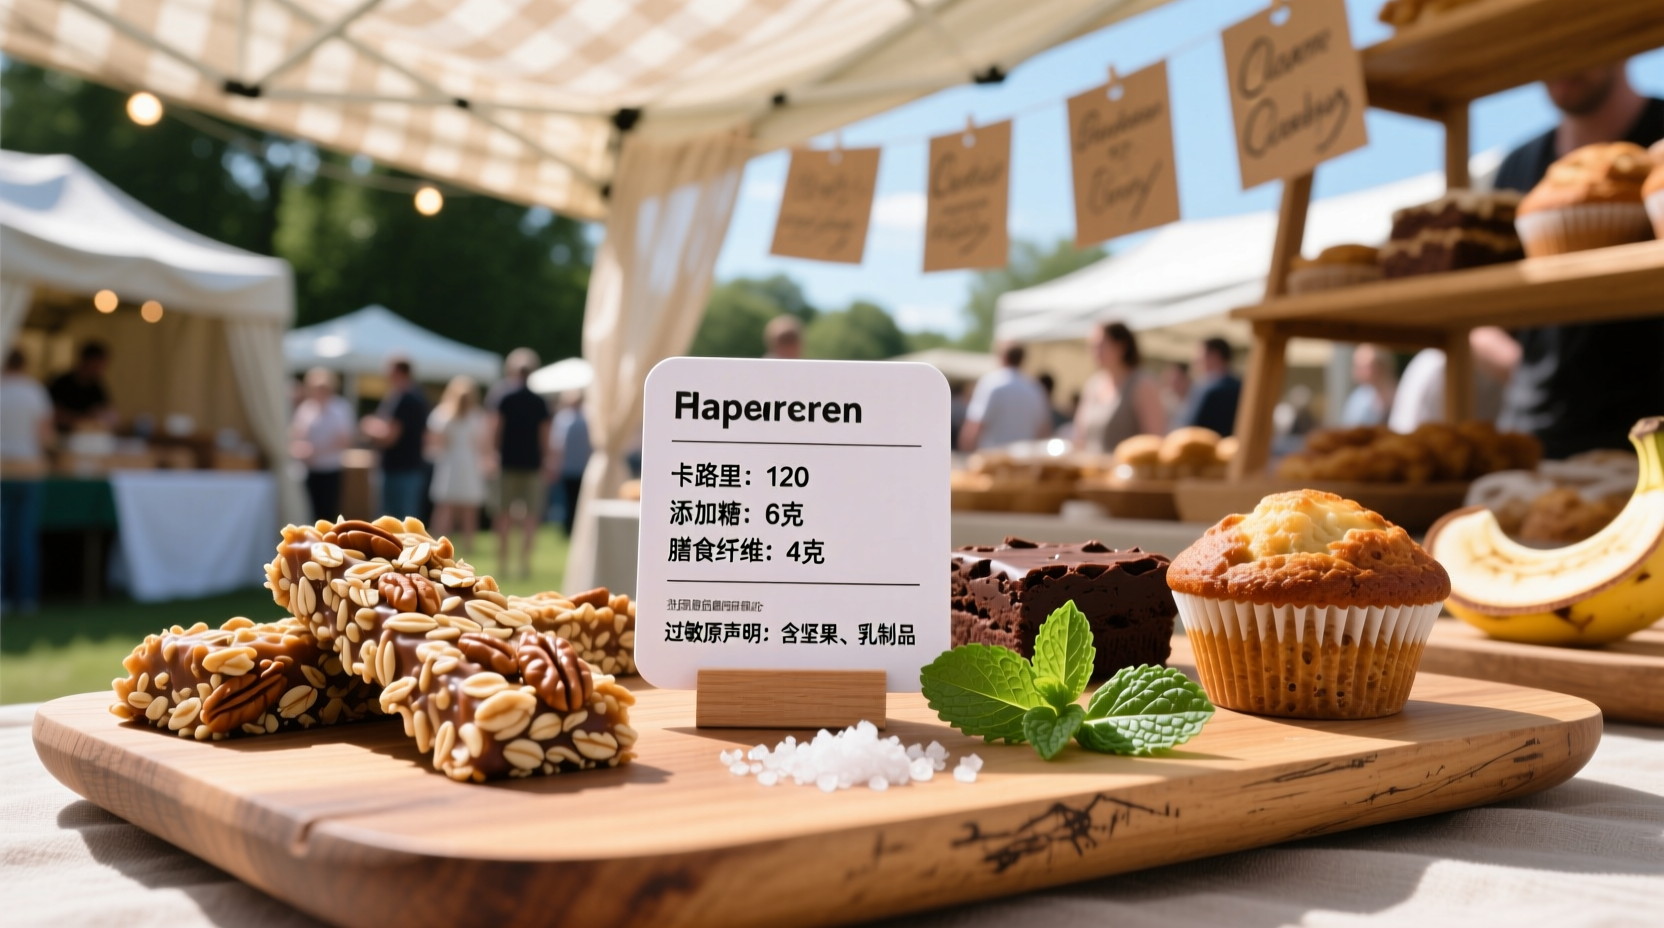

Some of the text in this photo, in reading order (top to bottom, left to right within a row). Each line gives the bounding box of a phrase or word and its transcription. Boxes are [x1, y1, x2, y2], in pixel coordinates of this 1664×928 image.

[670, 461, 810, 488] 卡路里：120
[669, 499, 804, 527] 添加糖：6克
[667, 535, 825, 564] 膳食纤维：4克
[664, 620, 916, 646] 过敏原声明：含坚果、乳制品
